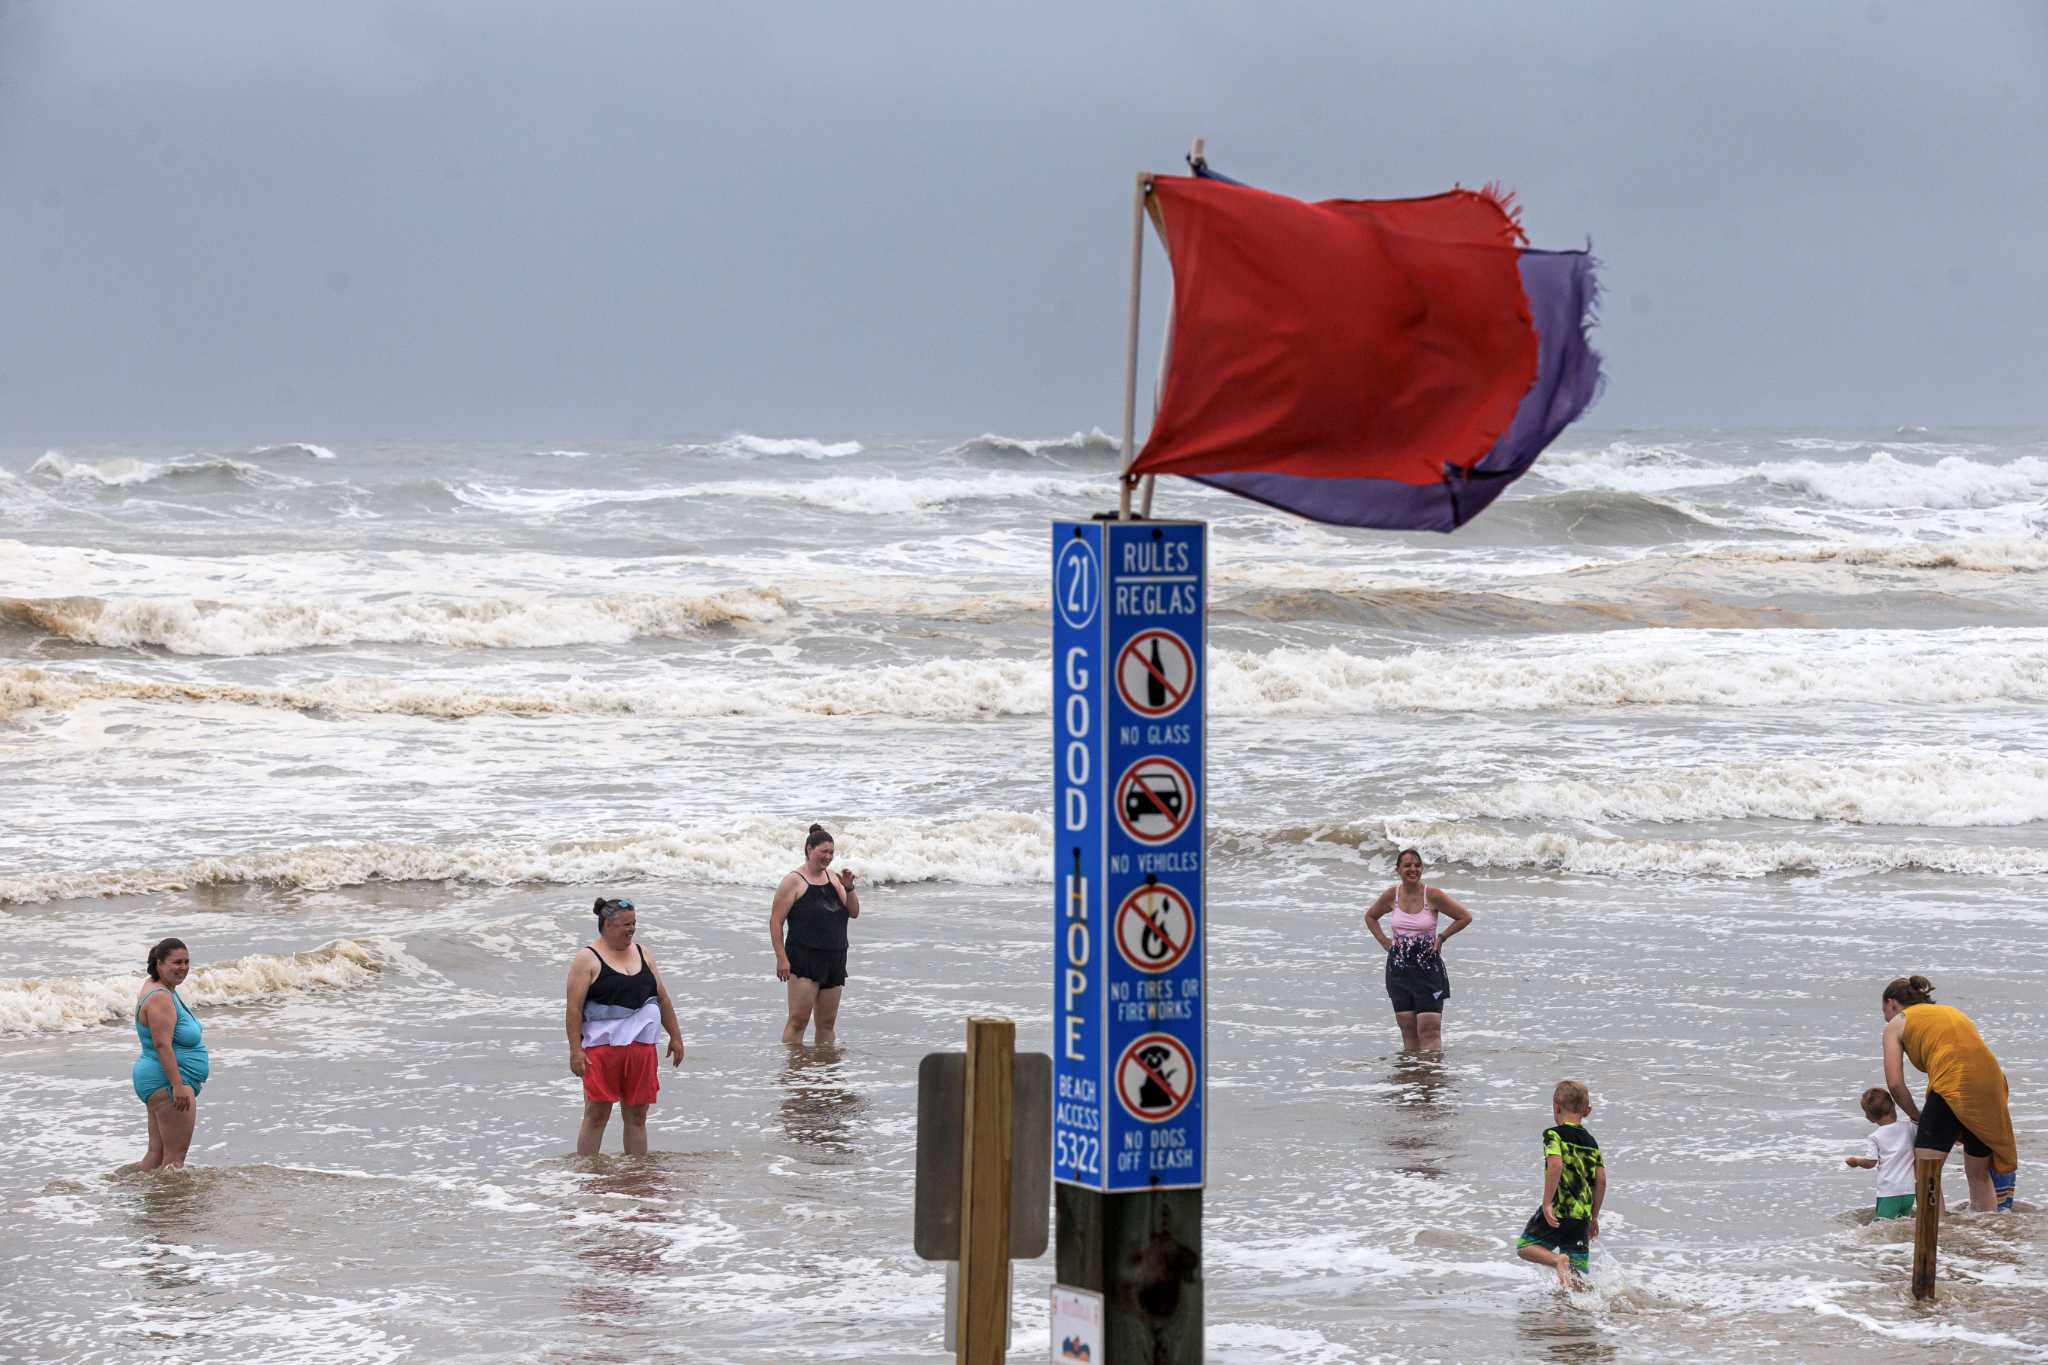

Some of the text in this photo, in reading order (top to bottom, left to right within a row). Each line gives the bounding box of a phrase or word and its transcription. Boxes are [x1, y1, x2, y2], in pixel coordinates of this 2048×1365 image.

[1123, 542, 1189, 573] RULES
[1067, 555, 1088, 613] 21
[1115, 585, 1197, 615] REGLAS
[1066, 647, 1089, 831] GOOD
[1120, 724, 1190, 745] NO GLASS
[1110, 852, 1198, 874] NO VEHICLES
[1065, 874, 1090, 1060] HOPE
[1110, 978, 1199, 1001] NO FIRES OR
[1118, 1000, 1192, 1022] FIREWORKS
[1059, 1075, 1096, 1102] BEACH
[1057, 1103, 1100, 1131] ACCESS
[1057, 1131, 1100, 1174] 5322
[1124, 1129, 1186, 1150] NO DOGS
[1118, 1149, 1193, 1171] OFF LEASH
